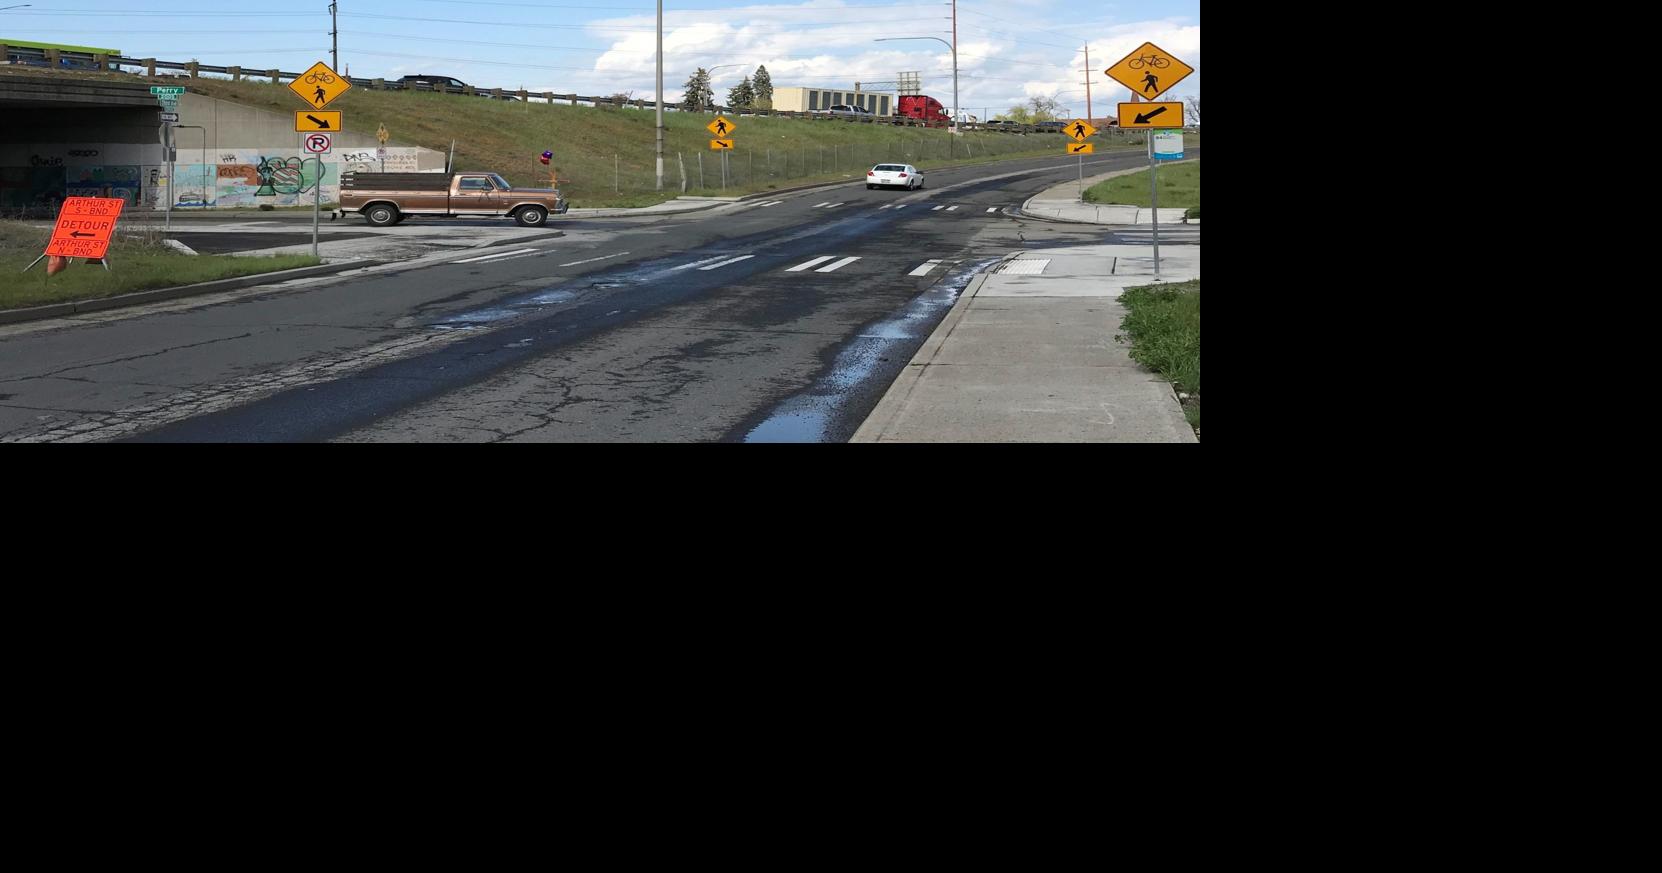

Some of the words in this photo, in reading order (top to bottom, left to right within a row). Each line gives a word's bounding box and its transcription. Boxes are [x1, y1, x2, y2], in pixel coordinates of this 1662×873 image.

[61, 220, 109, 230] DETOUR
[53, 239, 90, 247] ARTHUR
[93, 241, 104, 249] ST
